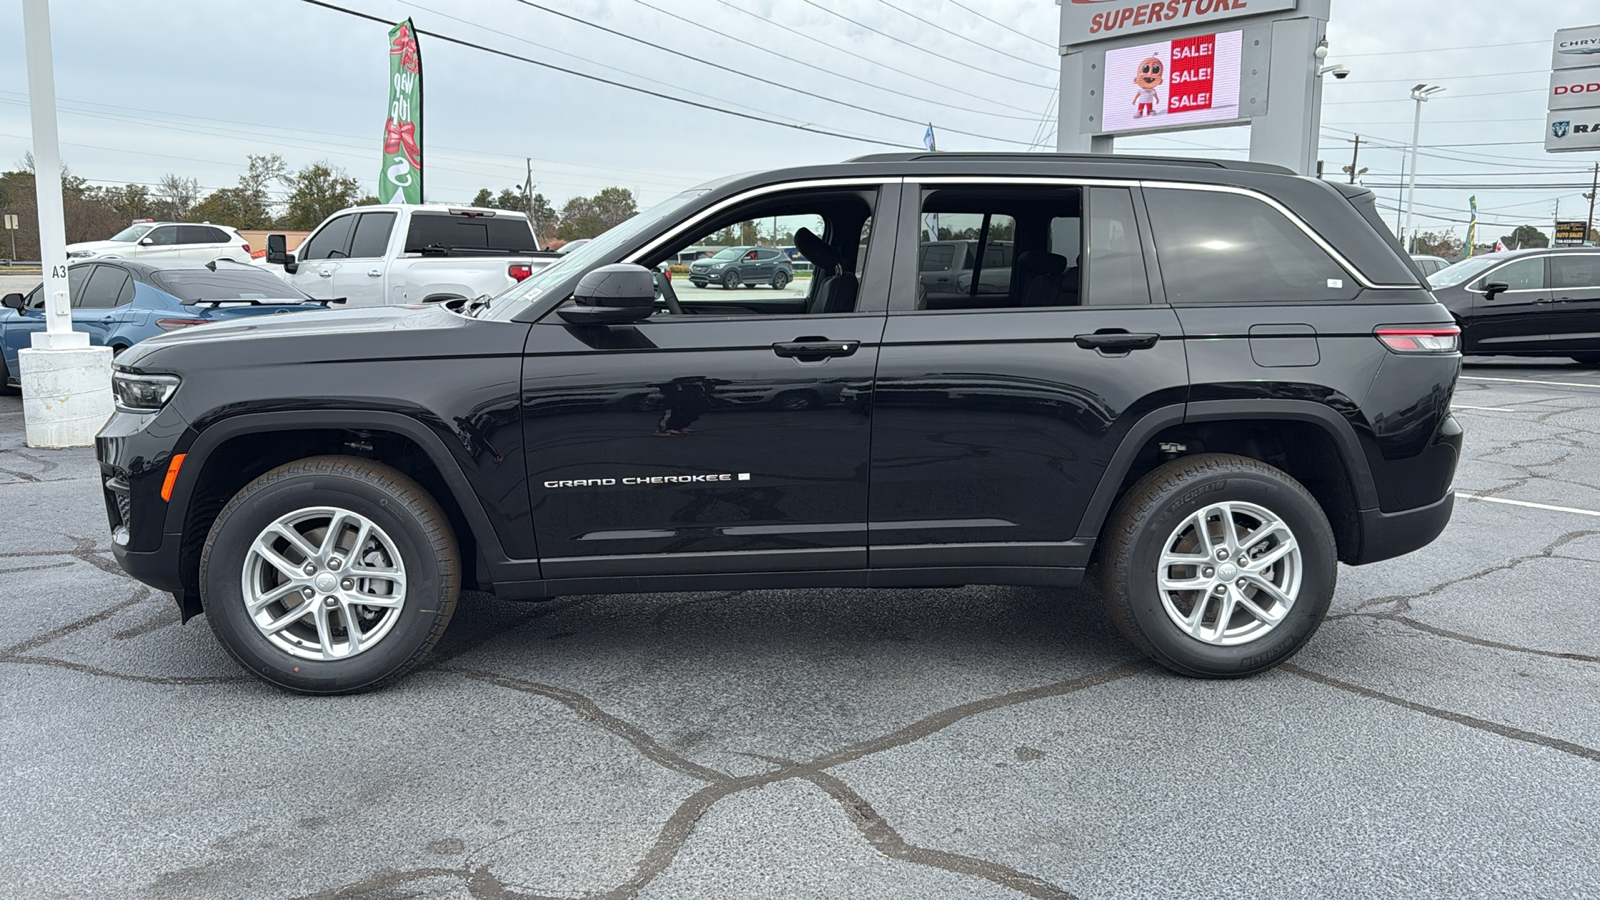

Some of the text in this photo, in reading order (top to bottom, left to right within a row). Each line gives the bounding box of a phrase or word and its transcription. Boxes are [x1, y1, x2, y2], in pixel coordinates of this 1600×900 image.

[1559, 38, 1600, 48] CHRY
[1172, 43, 1213, 60] SALE!
[1171, 67, 1212, 84] SALE!
[1553, 83, 1600, 96] DOD
[1169, 92, 1210, 109] SALE!
[52, 264, 67, 279] A3
[543, 473, 732, 489] GRAND CHEROKEE
